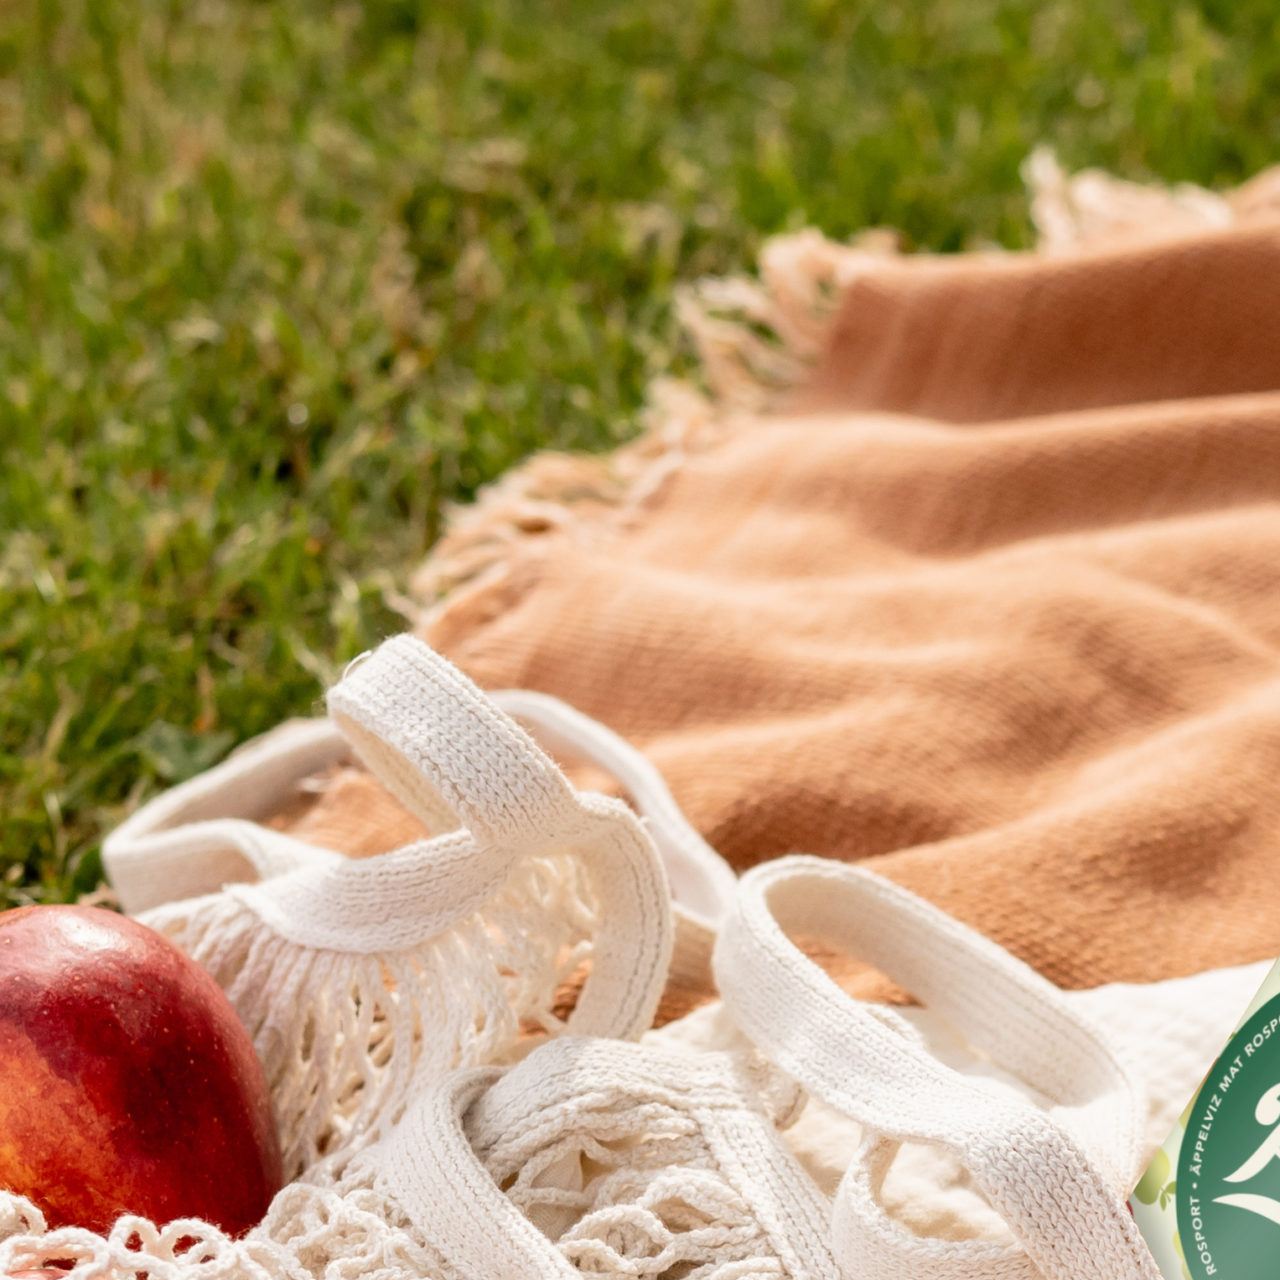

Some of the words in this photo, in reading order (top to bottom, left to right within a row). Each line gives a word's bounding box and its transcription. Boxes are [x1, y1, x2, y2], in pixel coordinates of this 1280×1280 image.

[1189, 1094, 1222, 1176] ÄPPELVIZ
[1218, 1055, 1245, 1093] MAT
[1189, 1195, 1217, 1276] ROSPORT
